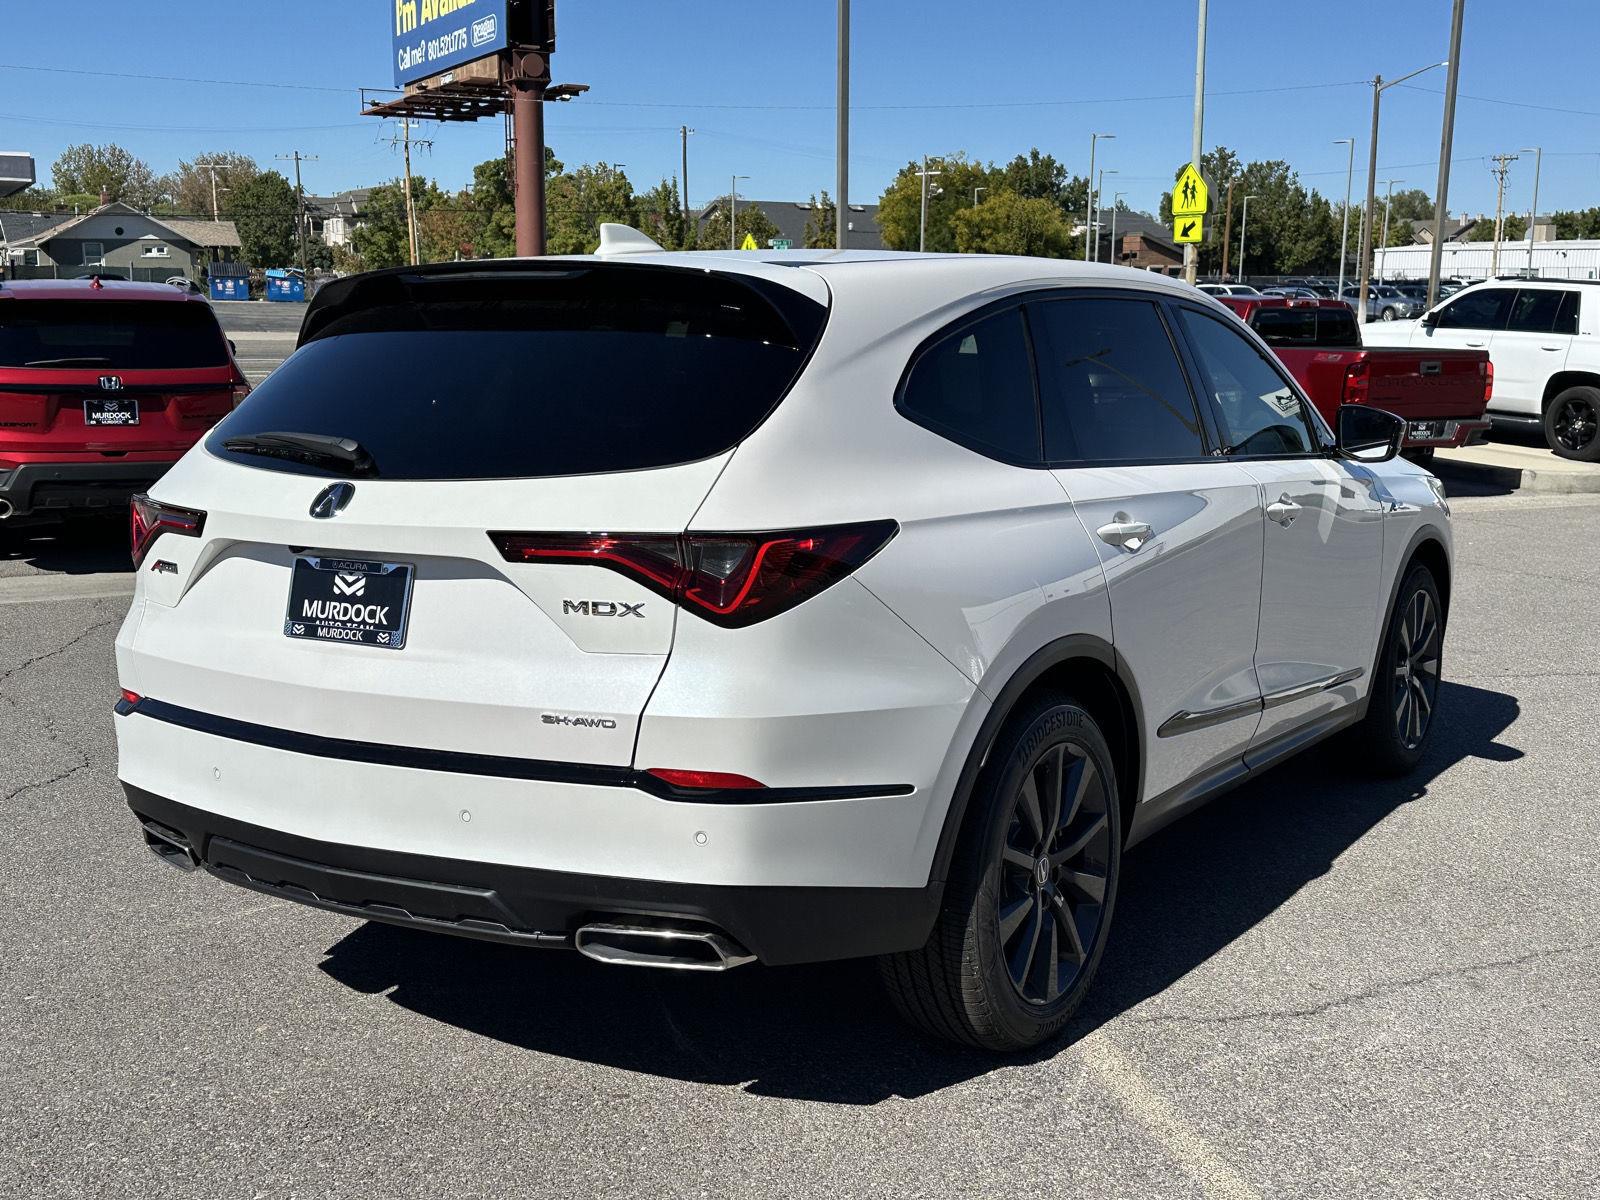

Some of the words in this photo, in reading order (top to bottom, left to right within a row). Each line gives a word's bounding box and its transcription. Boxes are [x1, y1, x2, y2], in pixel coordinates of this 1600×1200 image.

[398, 46, 411, 71] Call
[411, 39, 426, 66] me?
[339, 561, 368, 571] ACURA
[302, 599, 390, 625] MURDOCK
[562, 600, 645, 618] MDX
[317, 627, 363, 641] MURDOCK
[541, 714, 617, 729] SH-AWD
